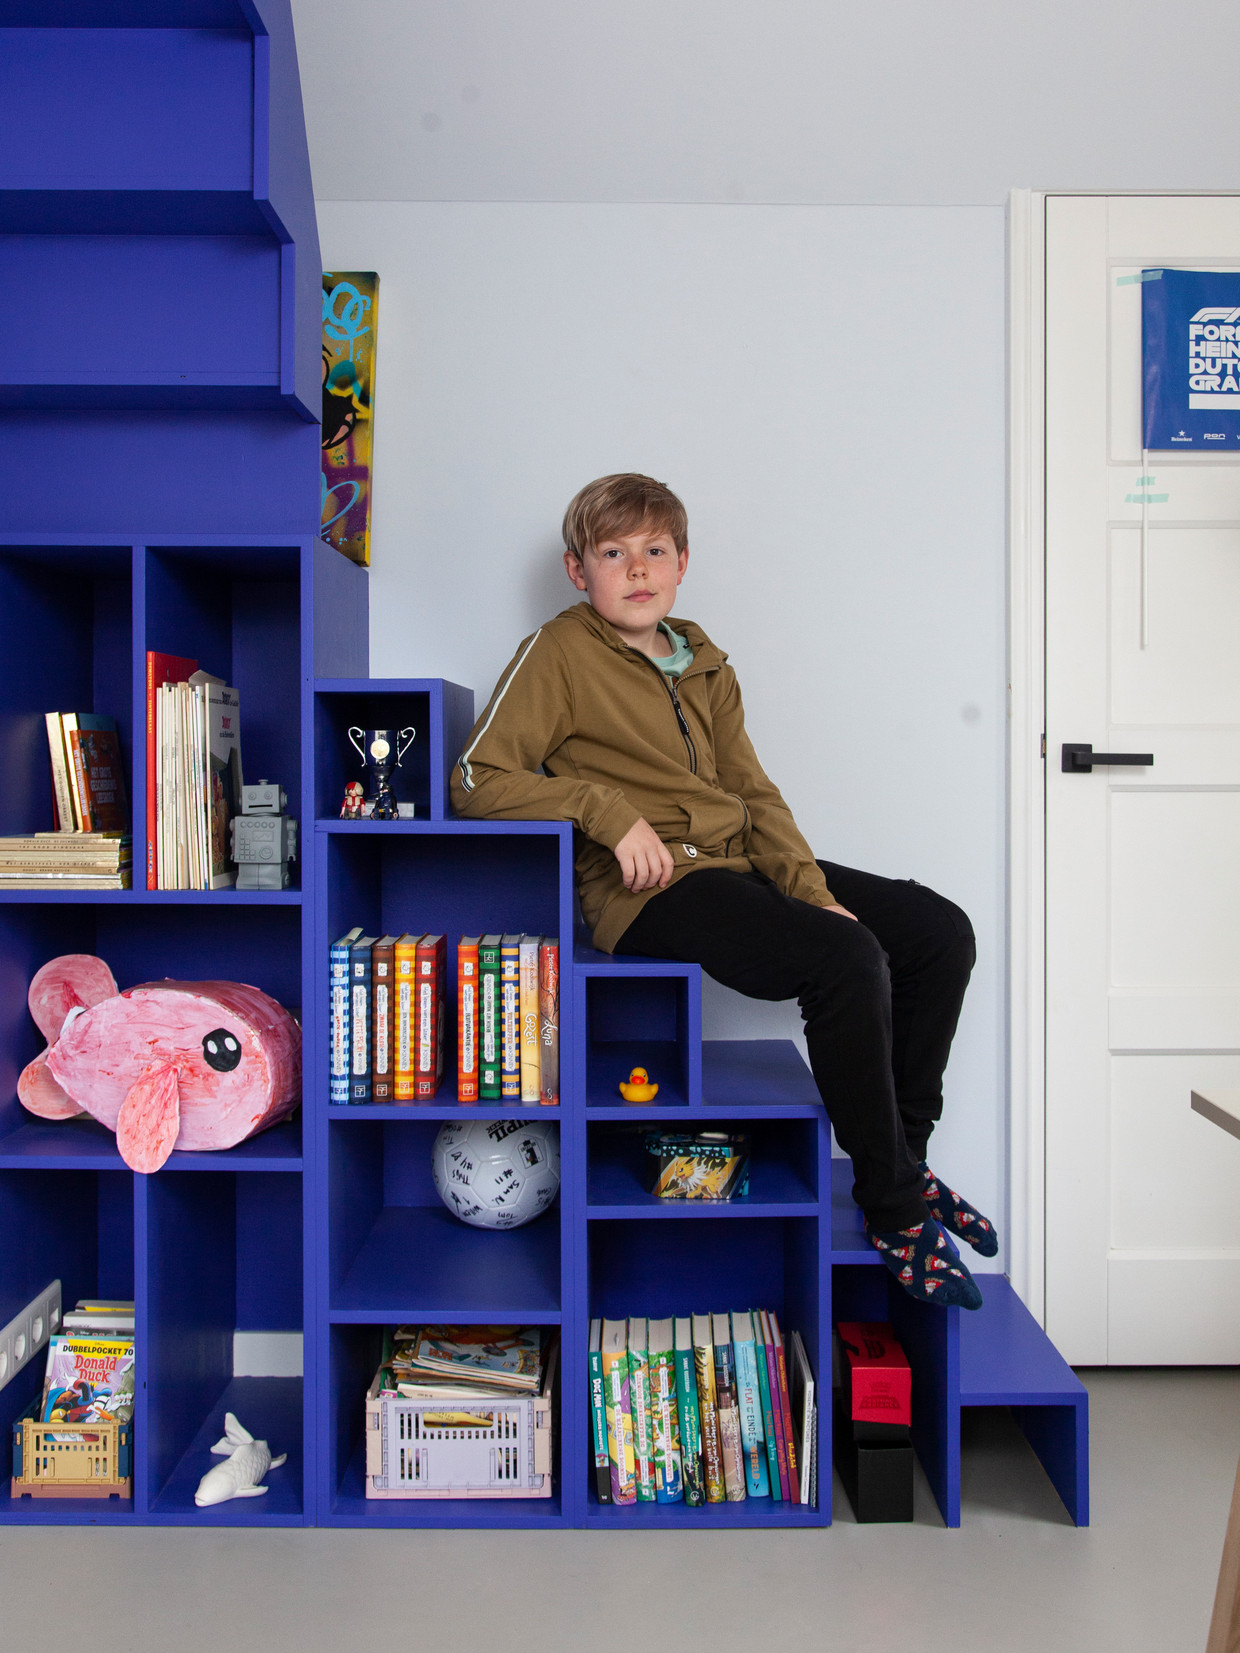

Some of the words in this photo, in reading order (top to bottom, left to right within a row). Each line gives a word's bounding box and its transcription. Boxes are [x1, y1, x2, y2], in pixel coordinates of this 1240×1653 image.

[1189, 324, 1240, 341] FOR
[1189, 358, 1240, 374] DUT
[1189, 375, 1240, 391] GRA
[63, 1345, 122, 1355] DUBBELPOCKET
[74, 1354, 118, 1371] Donald
[80, 1368, 110, 1384] Duck
[593, 1378, 602, 1393] DOG
[594, 1394, 602, 1408] MAN
[745, 1388, 753, 1404] FLAT
[747, 1414, 756, 1436] EINDE
[750, 1445, 760, 1479] WERELD
